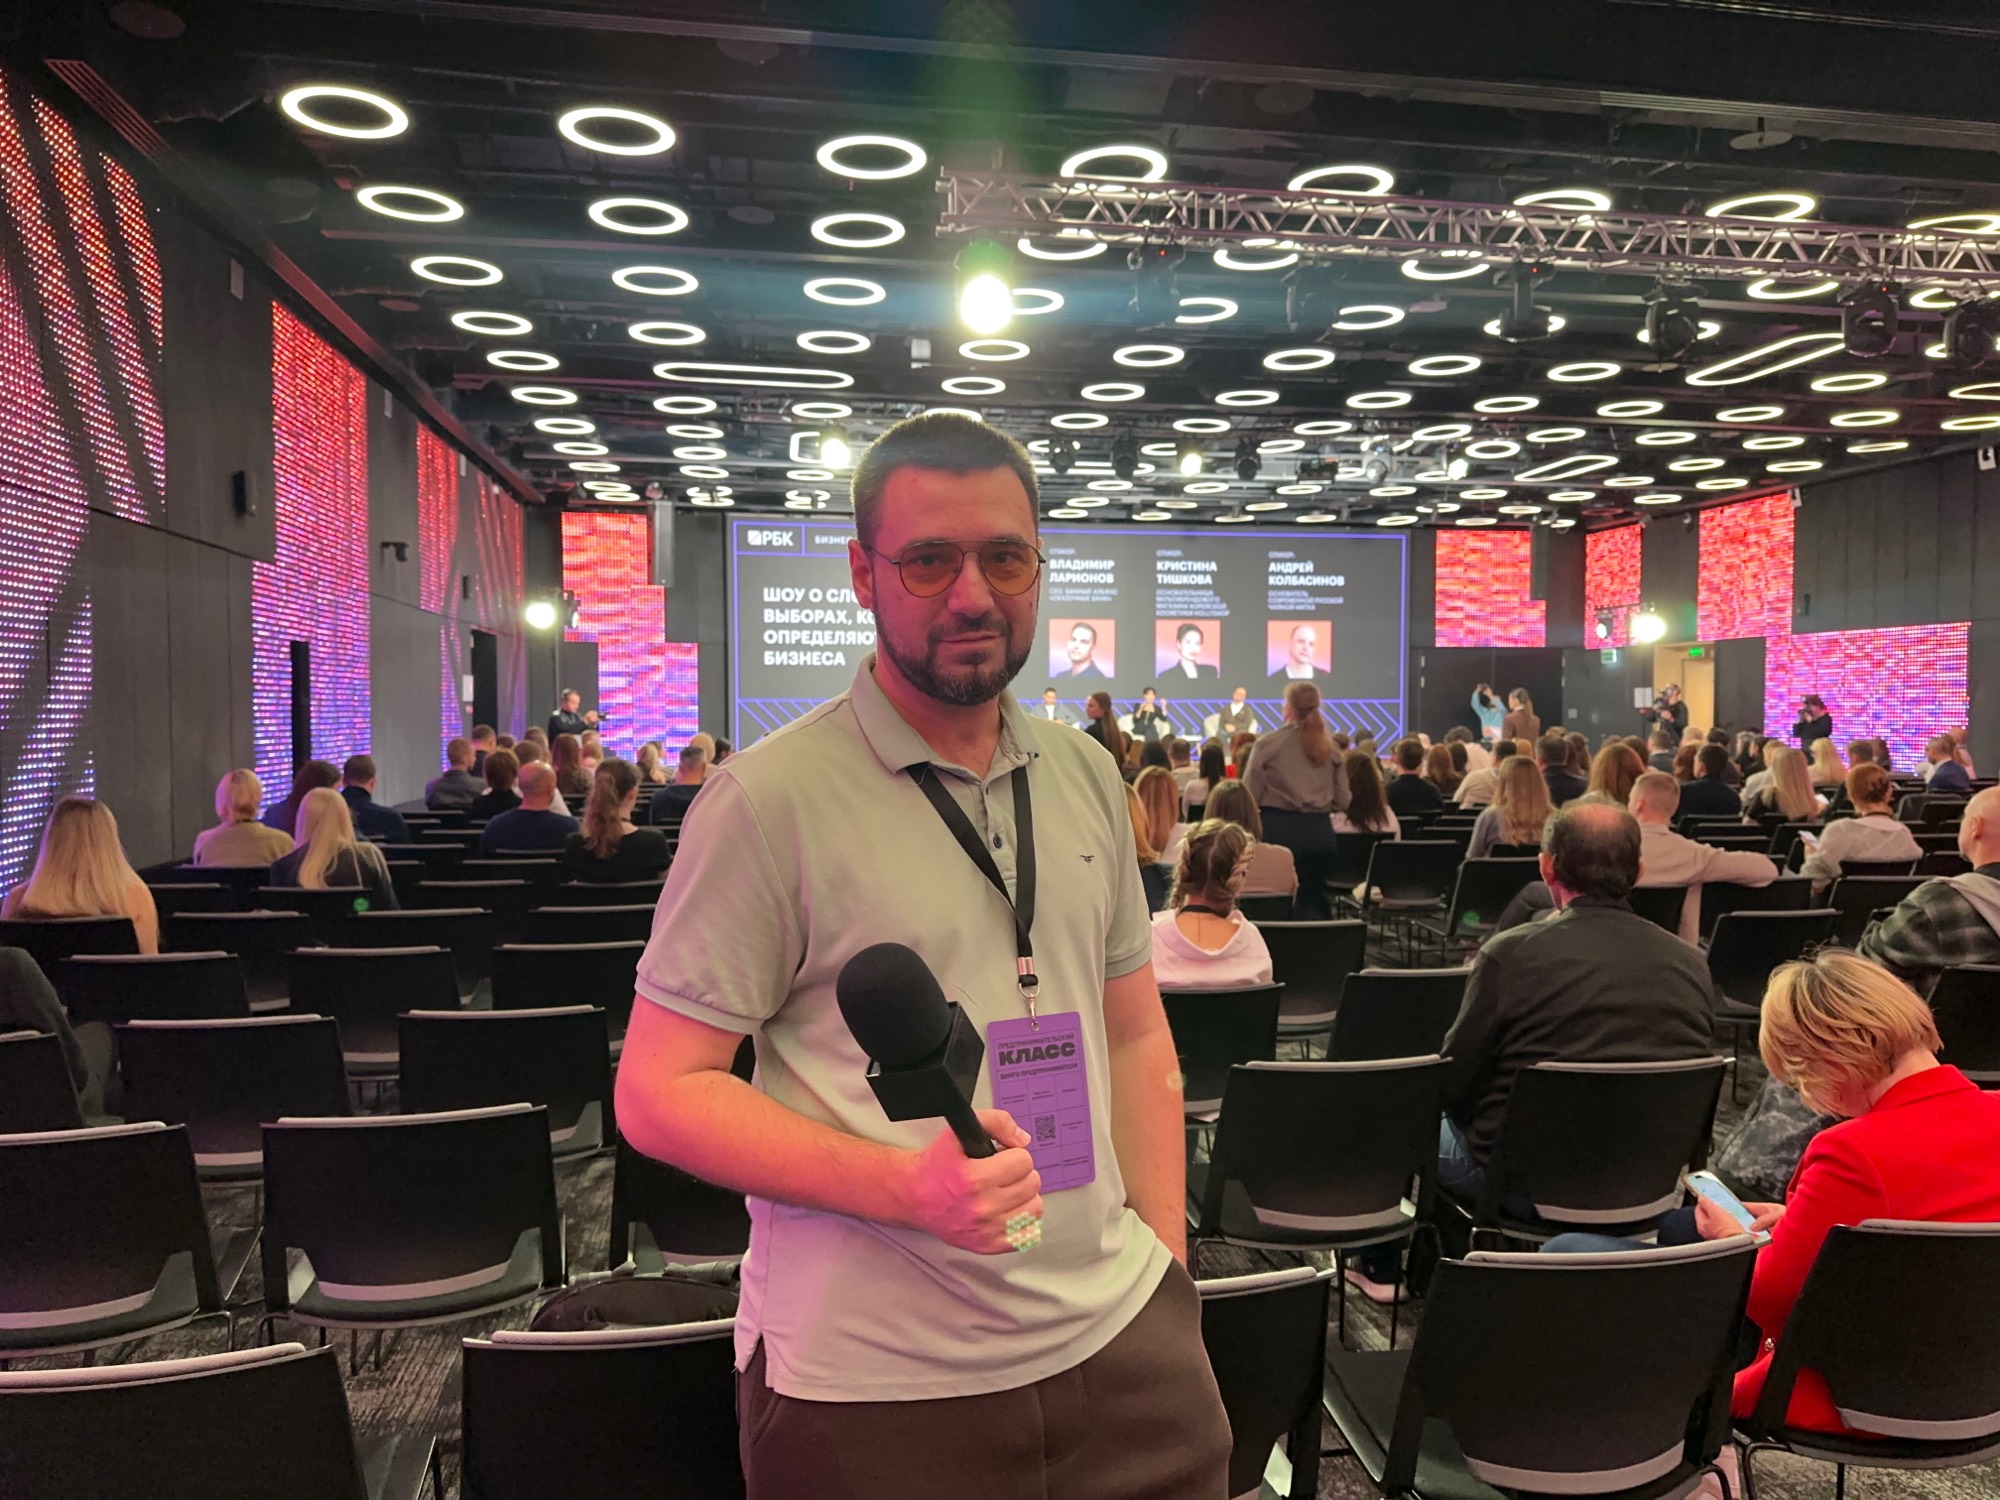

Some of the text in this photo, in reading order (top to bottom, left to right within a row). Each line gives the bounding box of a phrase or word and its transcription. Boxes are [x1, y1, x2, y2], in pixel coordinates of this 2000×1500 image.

[762, 530, 794, 546] РБК
[1049, 559, 1115, 571] ВЛАДИМИР
[1156, 561, 1217, 572] КРИСТИНА
[1269, 560, 1314, 574] АНДРЕЙ
[1049, 572, 1114, 583] ЛАРИОНОВ
[1156, 574, 1213, 585] ТИШКОВА
[1268, 575, 1345, 587] КОЛБАСИНОВ
[763, 587, 805, 603] ШОУ
[809, 588, 823, 603] О
[763, 608, 876, 626] ВЫБОРАХ, КО
[763, 629, 877, 647] ОПРЕДЕЛЯЮ
[764, 650, 846, 666] БИЗНЕСА
[998, 1041, 1076, 1066] КЛАСС
